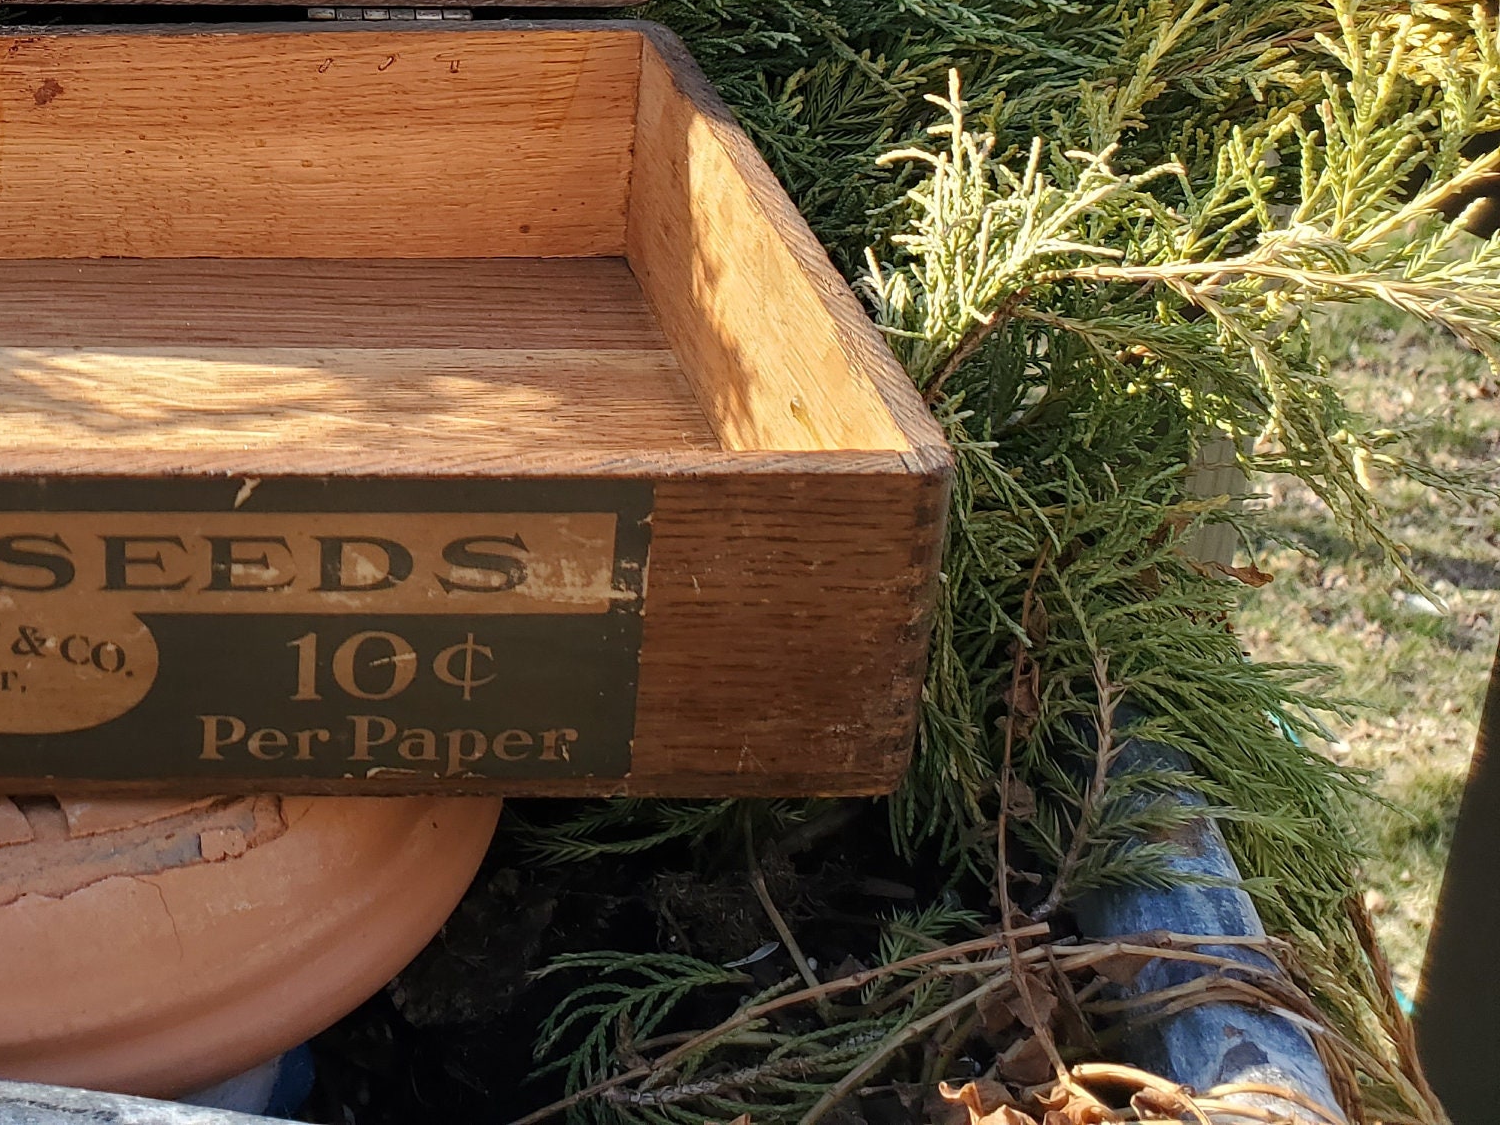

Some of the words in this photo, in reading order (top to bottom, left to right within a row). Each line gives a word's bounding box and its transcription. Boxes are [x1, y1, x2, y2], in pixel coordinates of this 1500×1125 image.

[11, 625, 52, 659] &
[59, 632, 134, 678] CO.
[199, 715, 331, 761] Per
[347, 715, 578, 775] Paper
